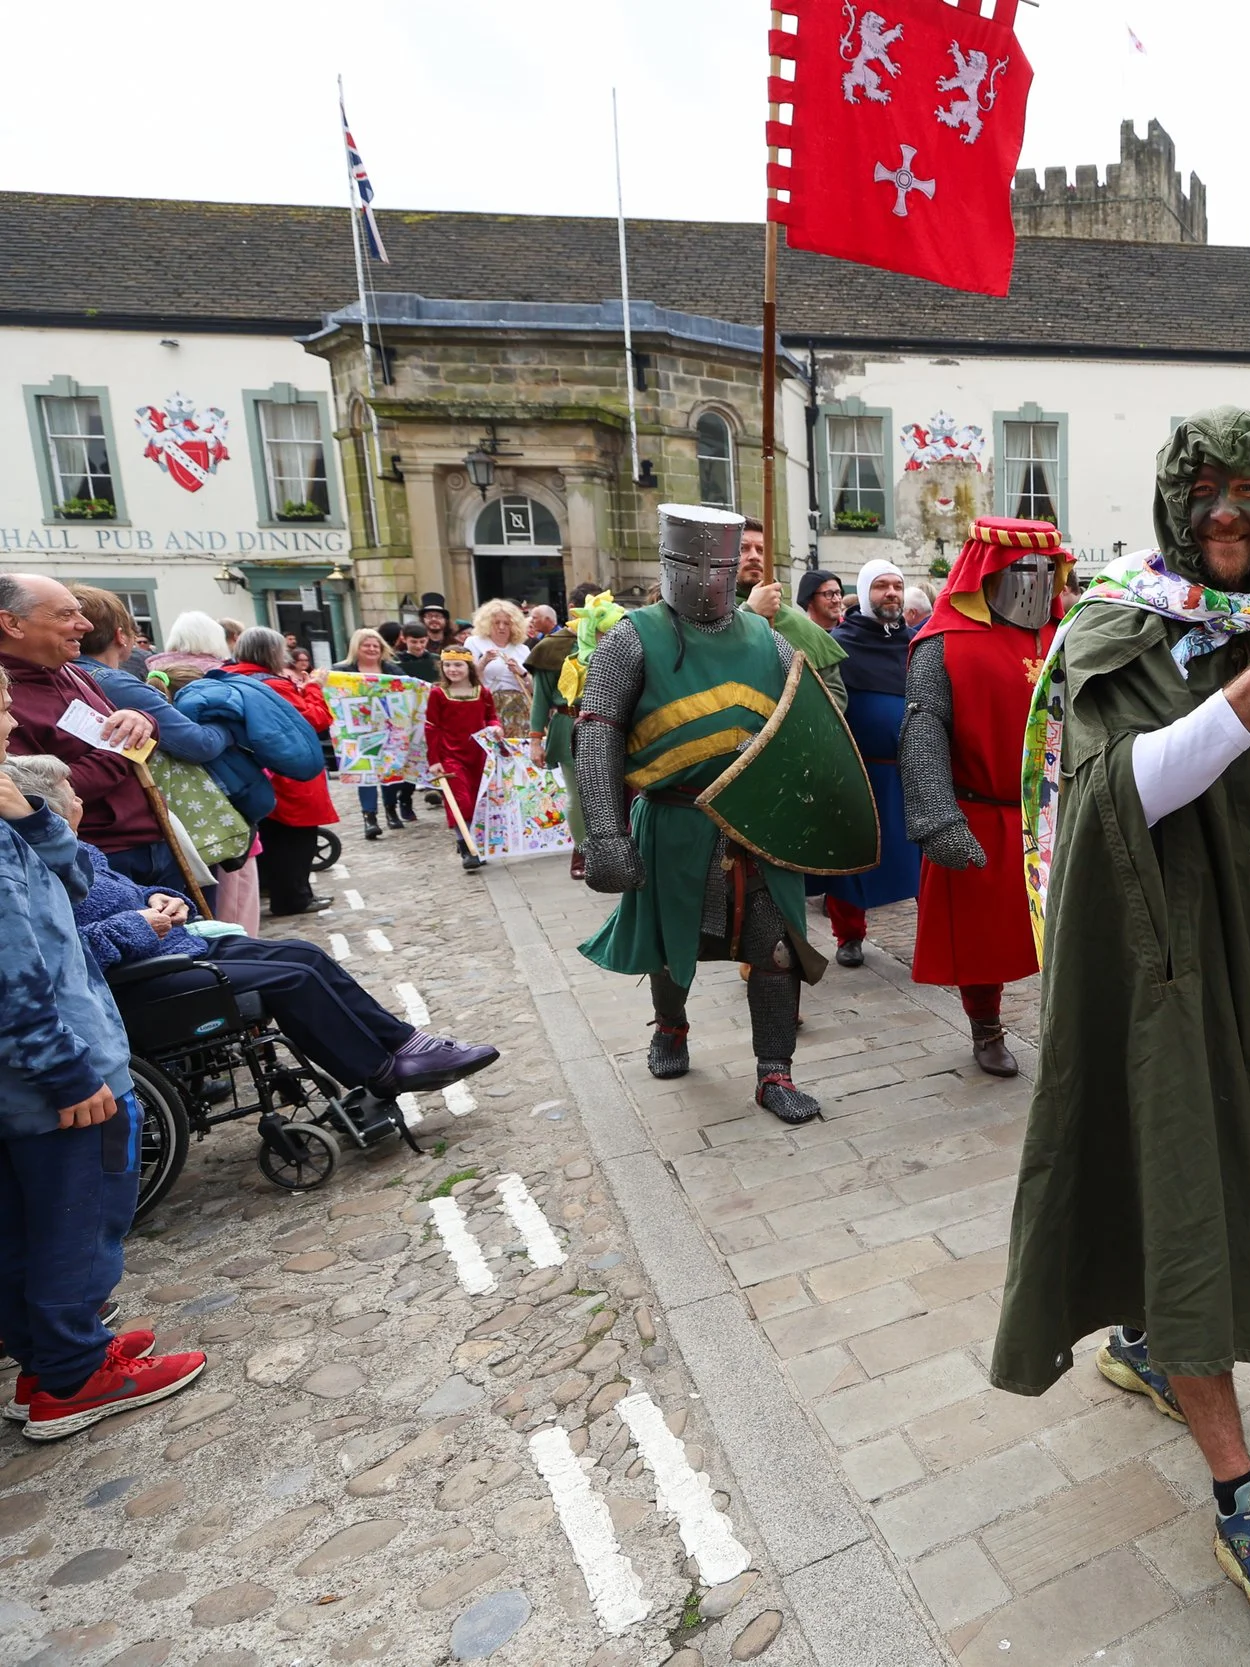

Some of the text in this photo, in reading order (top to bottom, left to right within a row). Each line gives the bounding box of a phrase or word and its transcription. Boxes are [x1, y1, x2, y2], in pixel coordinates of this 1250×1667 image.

[0, 528, 343, 551] HALL PUB AND DINING
